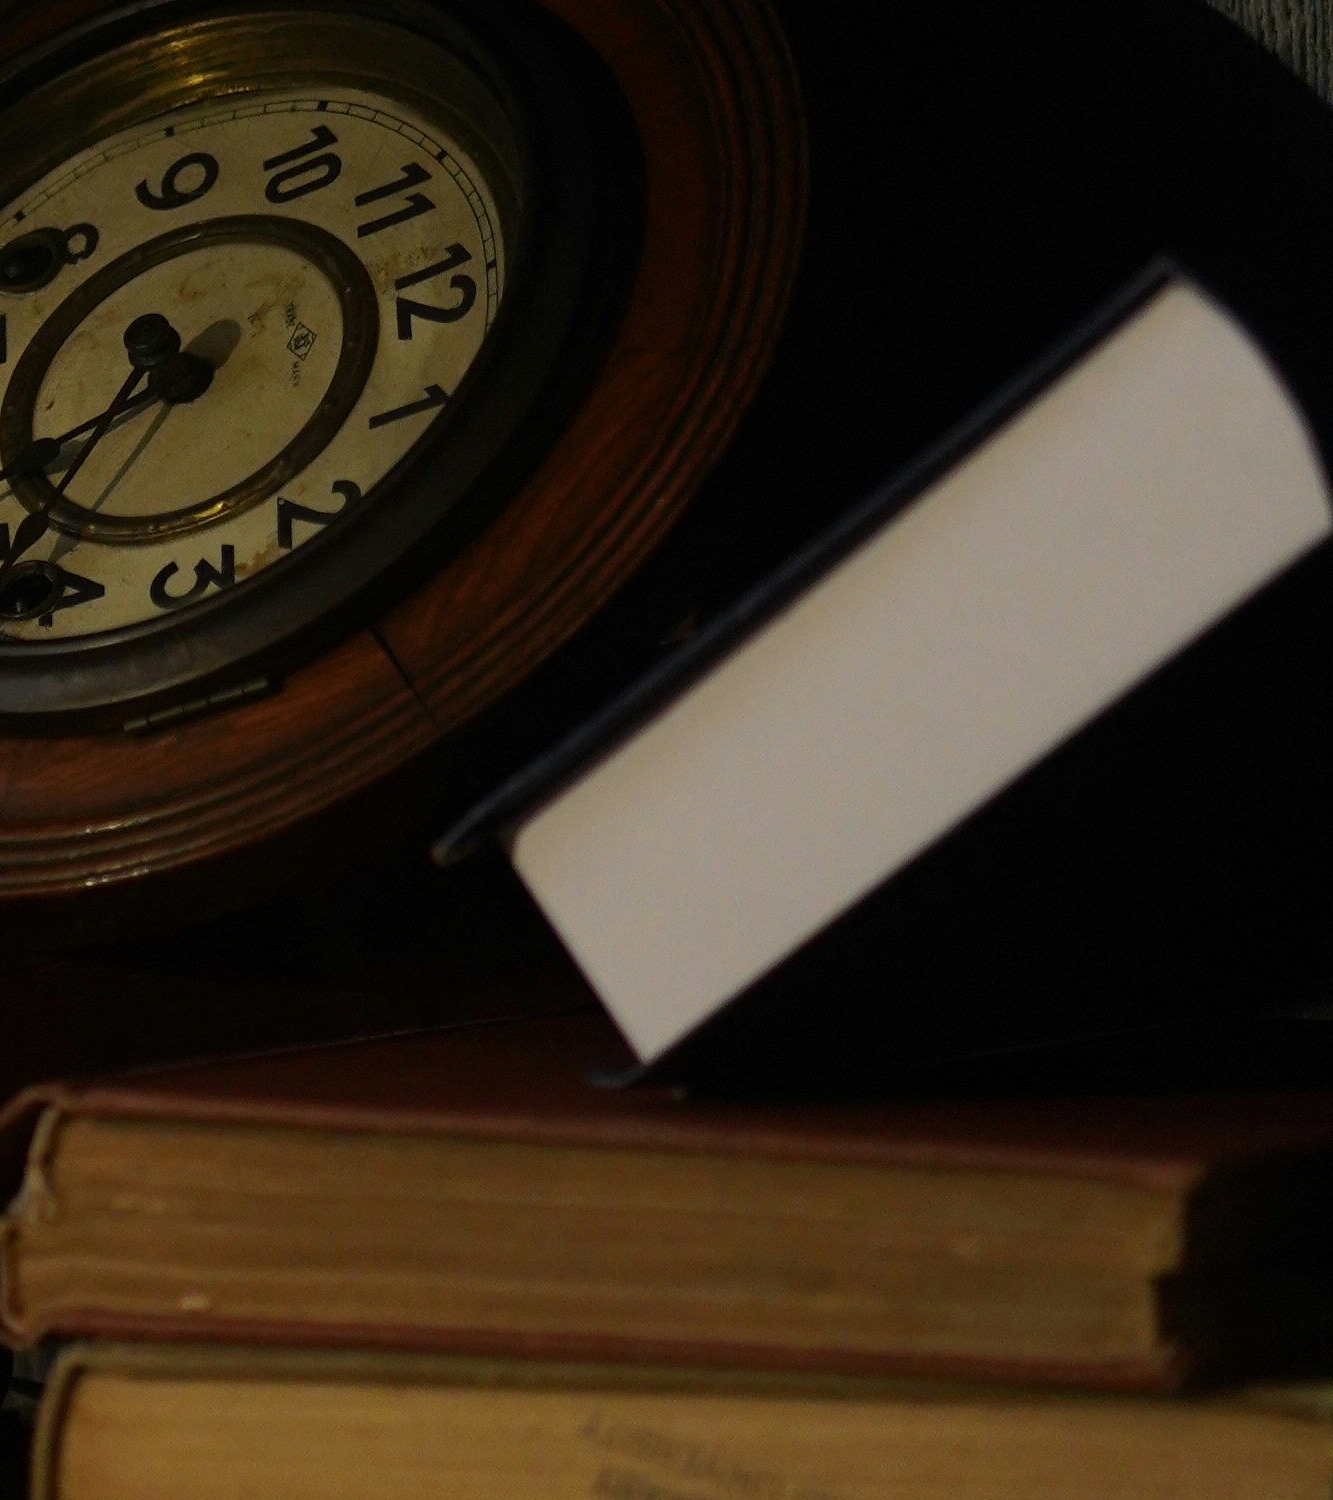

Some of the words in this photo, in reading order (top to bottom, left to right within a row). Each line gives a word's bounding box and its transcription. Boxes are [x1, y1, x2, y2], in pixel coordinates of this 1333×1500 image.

[134, 152, 220, 210] 9
[263, 125, 342, 204] 10
[355, 161, 437, 239] 11
[395, 242, 478, 341] 12
[369, 382, 451, 429] 1
[277, 479, 362, 549] 2
[149, 544, 235, 610] 3
